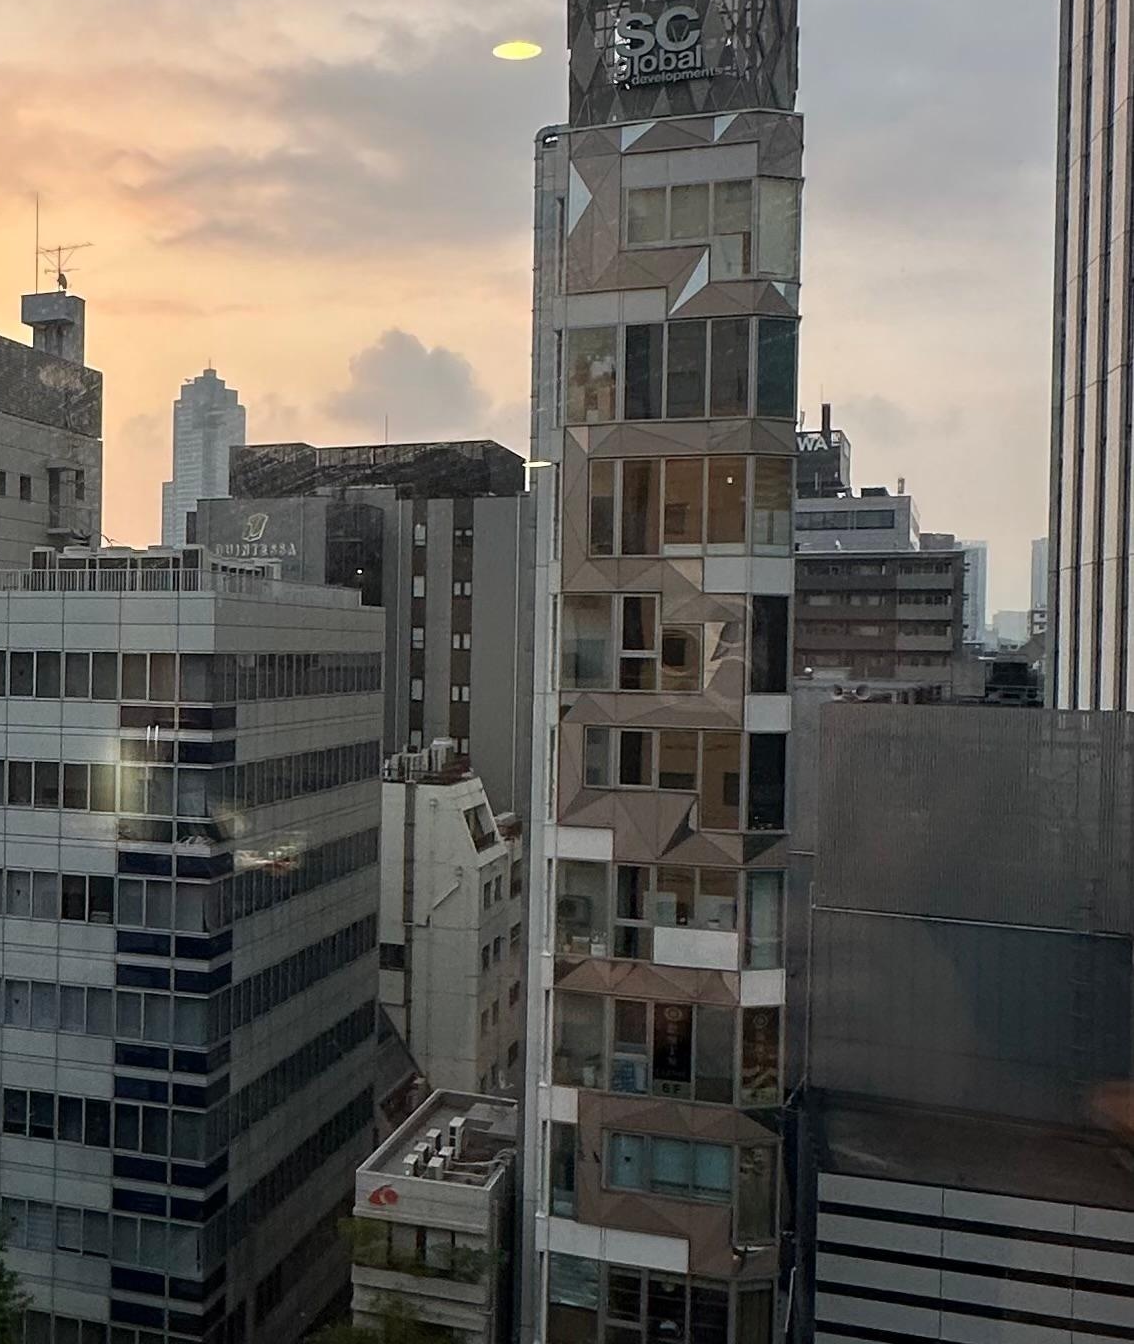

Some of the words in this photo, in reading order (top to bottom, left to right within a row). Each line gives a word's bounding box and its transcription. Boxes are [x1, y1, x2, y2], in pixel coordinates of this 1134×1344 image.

[616, 5, 701, 58] SC
[614, 45, 703, 83] global
[631, 65, 723, 87] developments
[214, 543, 297, 557] QUINTESSA
